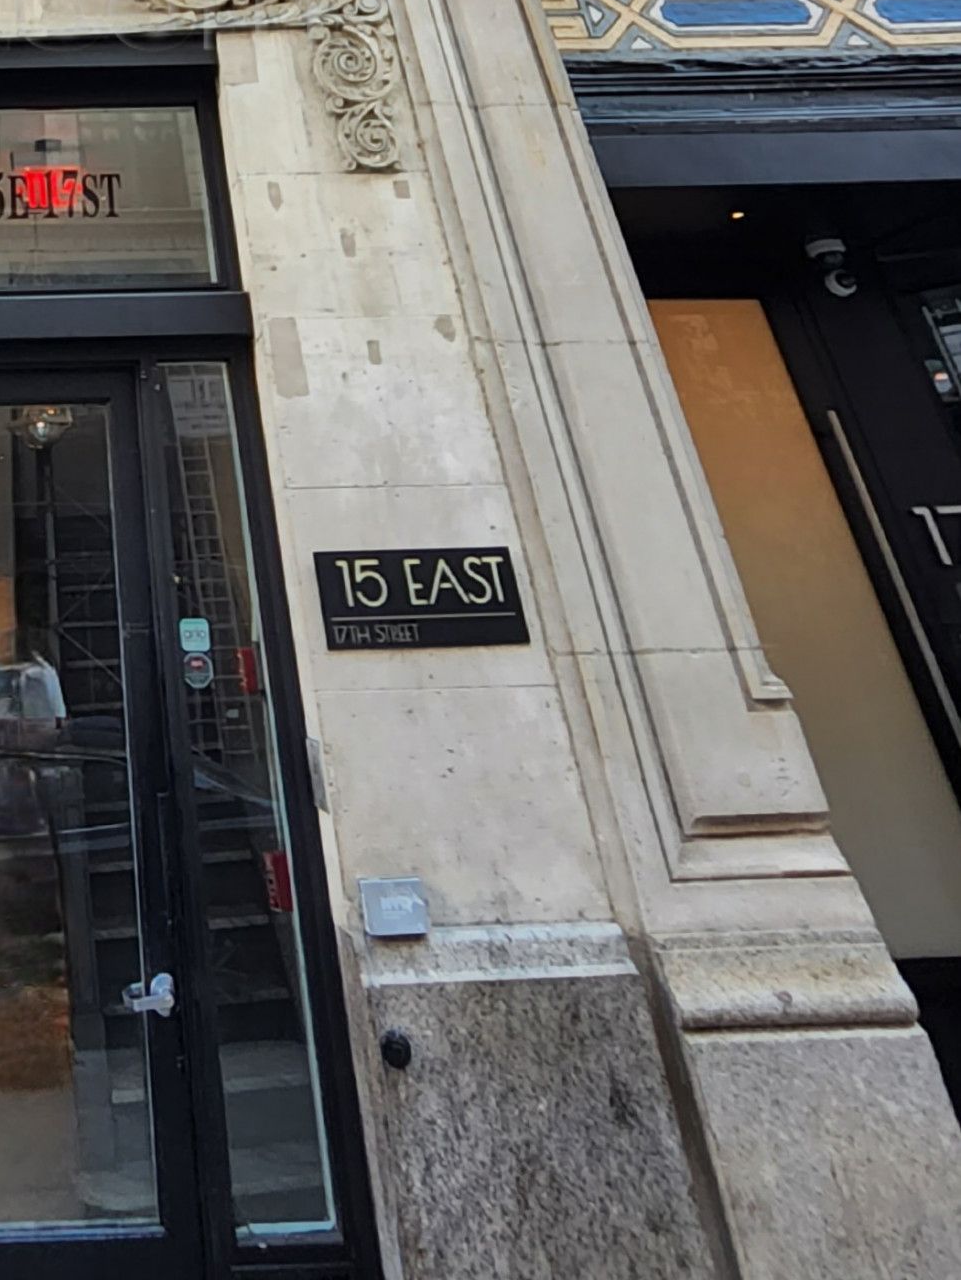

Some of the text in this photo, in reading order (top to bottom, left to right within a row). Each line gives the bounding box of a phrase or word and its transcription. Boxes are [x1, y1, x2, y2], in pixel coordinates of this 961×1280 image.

[334, 555, 504, 608] 15 EAST
[332, 623, 420, 645] 17TH STREET
